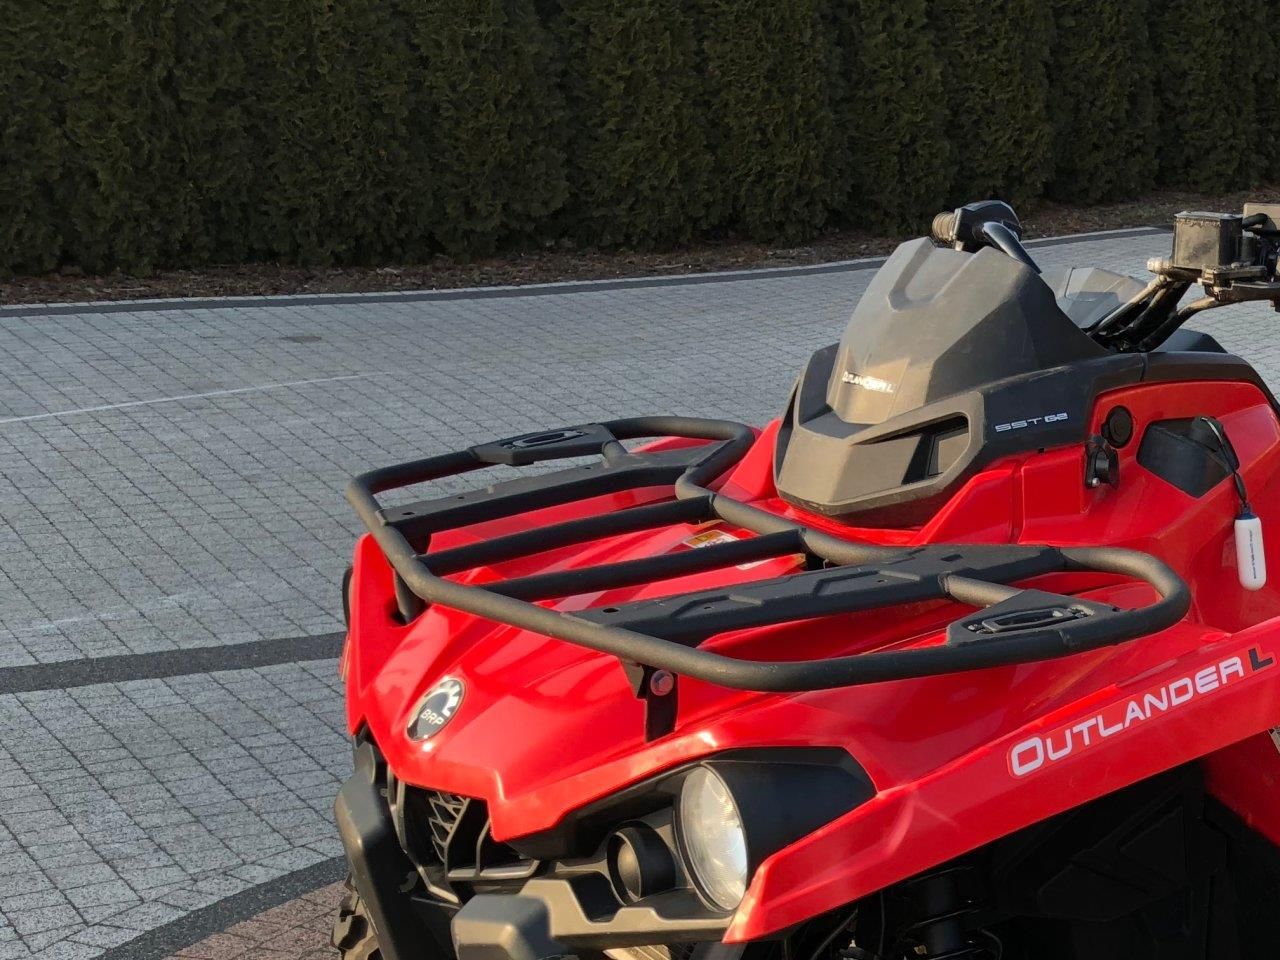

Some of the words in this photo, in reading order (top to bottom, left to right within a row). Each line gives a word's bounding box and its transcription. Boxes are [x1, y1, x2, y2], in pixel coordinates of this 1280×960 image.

[995, 418, 1042, 432] SST
[421, 709, 445, 725] BRP
[1011, 656, 1245, 777] OUTLANDER
[1248, 648, 1274, 672] L
